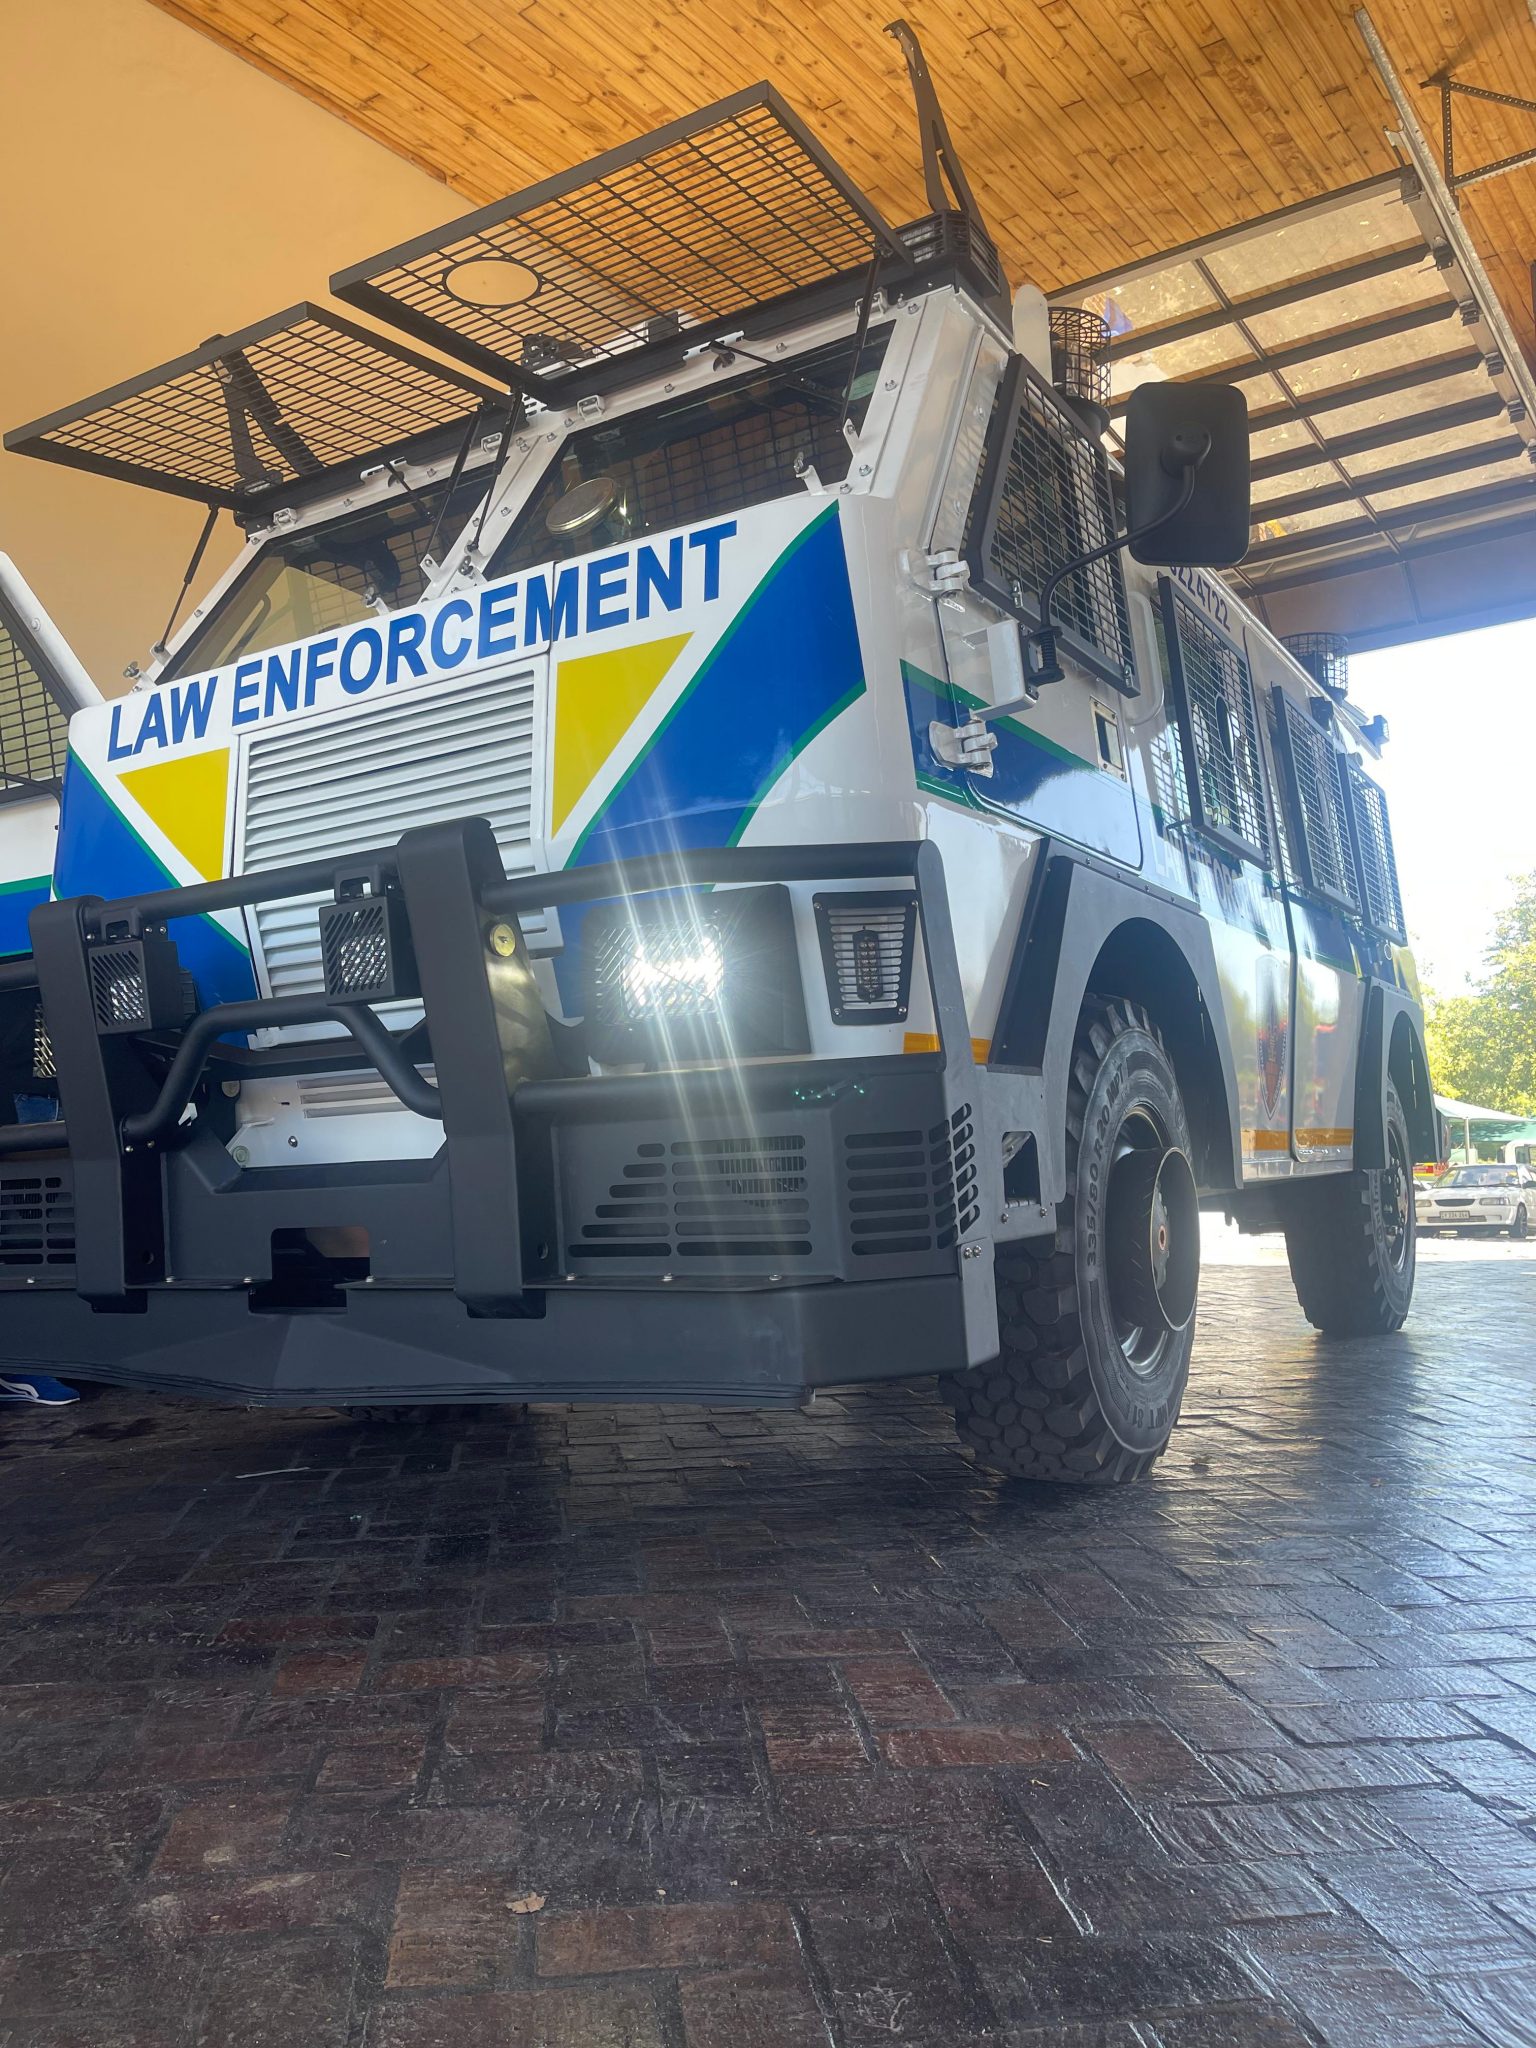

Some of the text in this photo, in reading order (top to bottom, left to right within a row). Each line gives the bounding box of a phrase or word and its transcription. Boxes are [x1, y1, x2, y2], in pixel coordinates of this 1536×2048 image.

[107, 519, 738, 762] LAW ENFORCEMENT
[1170, 567, 1231, 633] 224722
[1086, 1162, 1099, 1267] 335/80
[1094, 1109, 1111, 1159] R20
